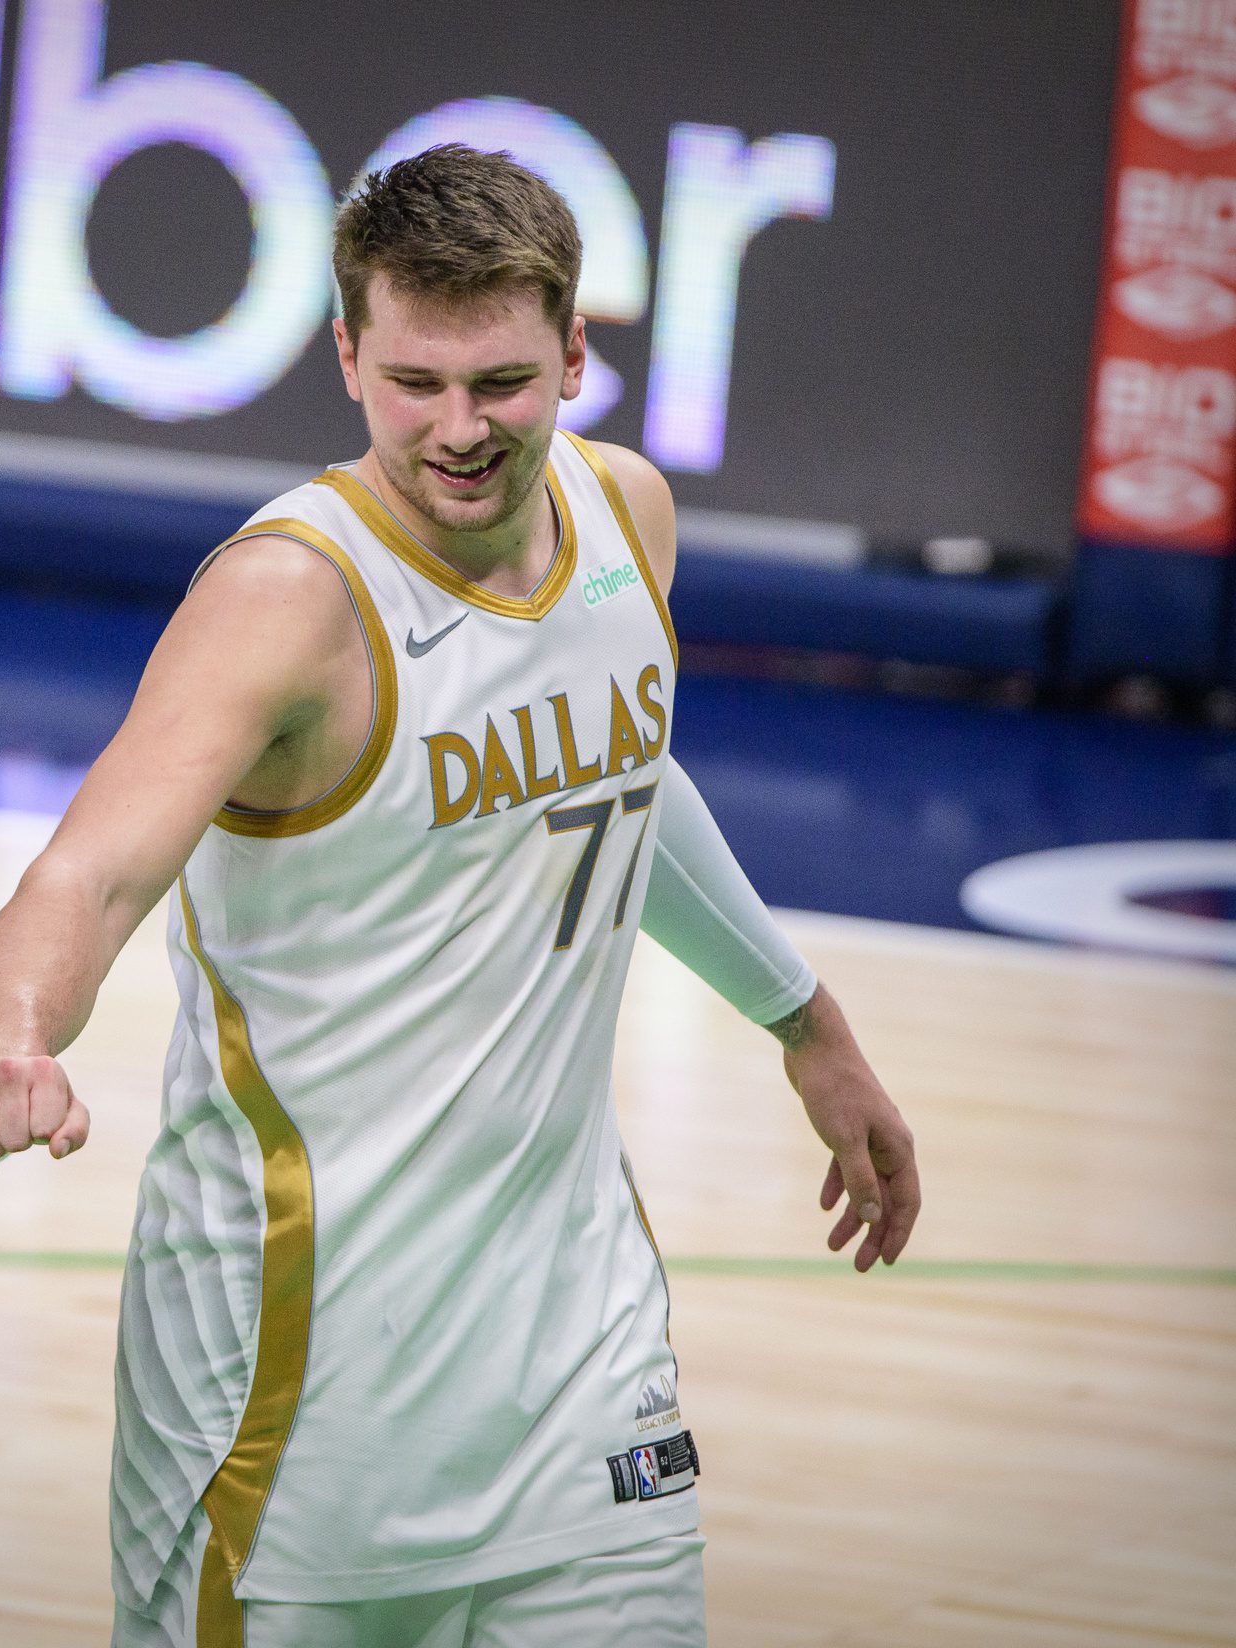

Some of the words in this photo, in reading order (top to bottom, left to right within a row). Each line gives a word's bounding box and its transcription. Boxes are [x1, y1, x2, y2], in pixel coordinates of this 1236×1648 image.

[583, 563, 638, 604] chime
[419, 664, 666, 830] DALLAS
[544, 777, 659, 952] 77
